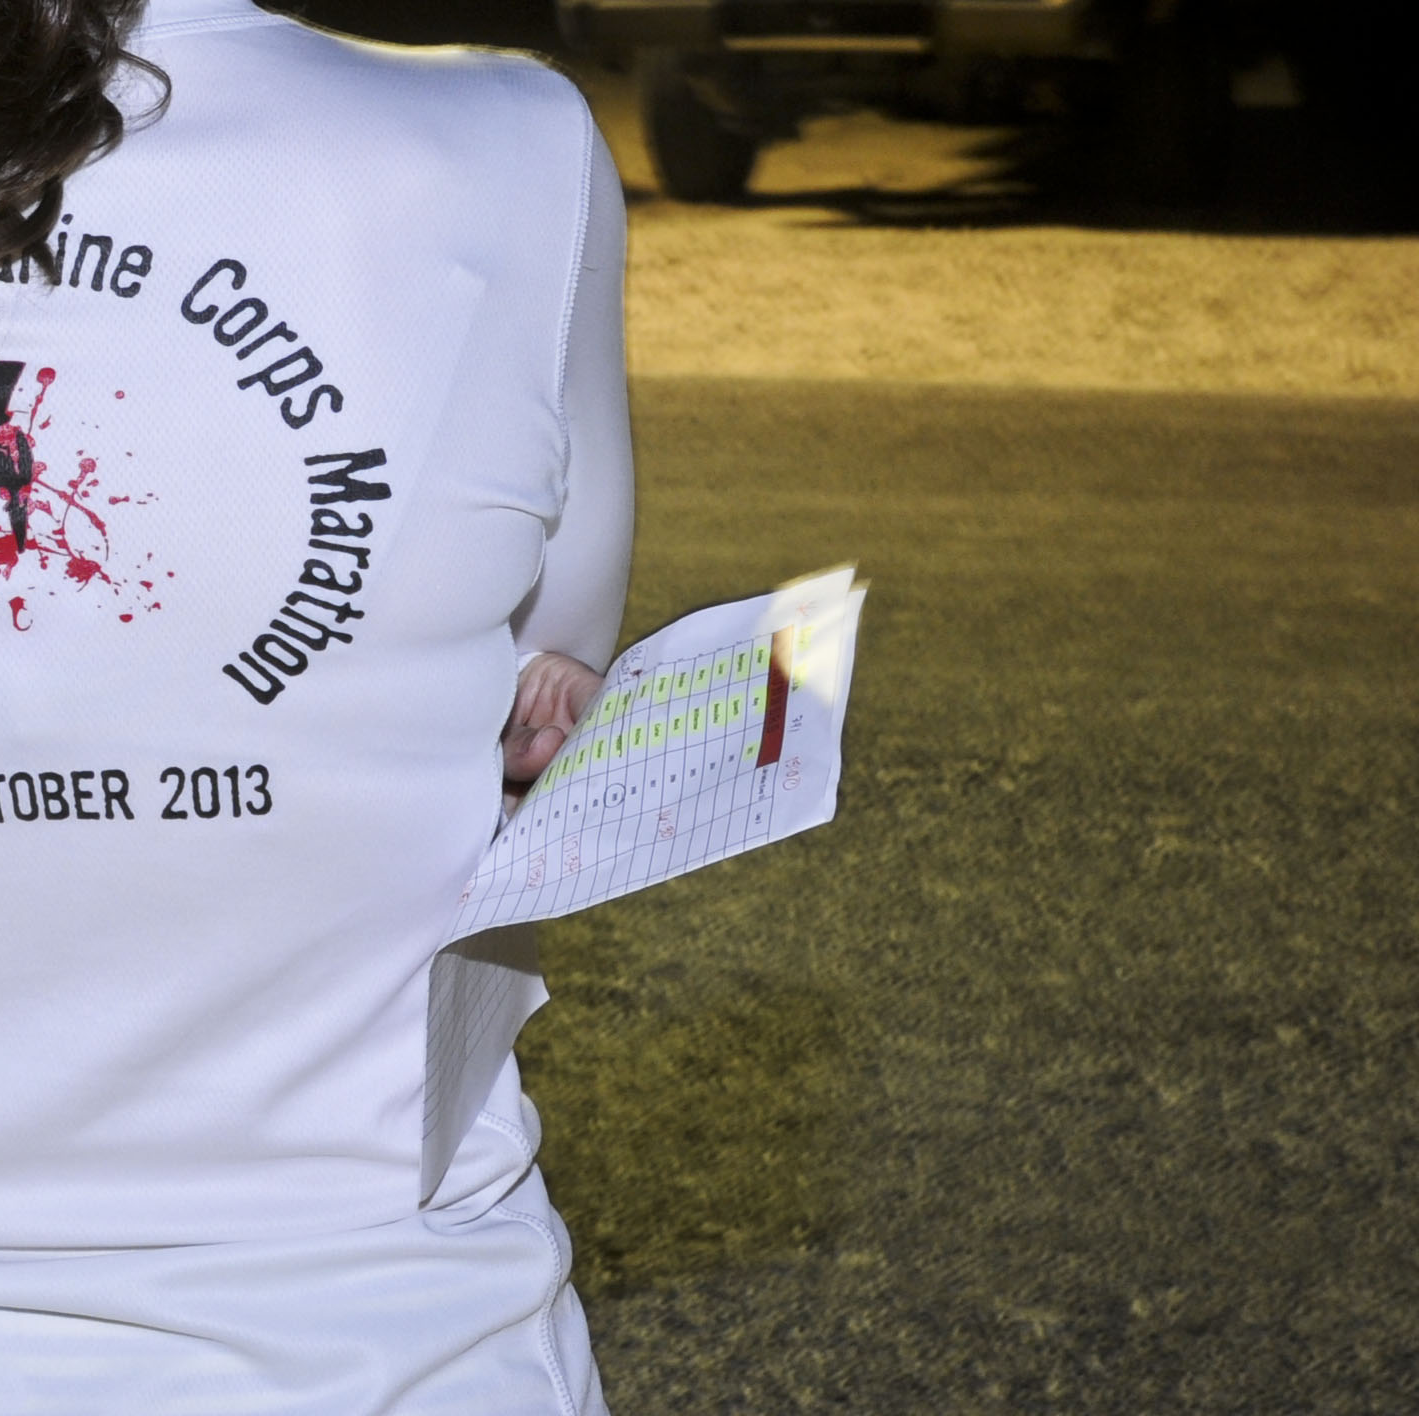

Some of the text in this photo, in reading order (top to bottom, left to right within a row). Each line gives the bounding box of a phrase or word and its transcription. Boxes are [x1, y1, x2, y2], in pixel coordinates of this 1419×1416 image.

[181, 258, 344, 430] Corps
[222, 448, 392, 706] Marathon
[159, 764, 273, 820] 2013
